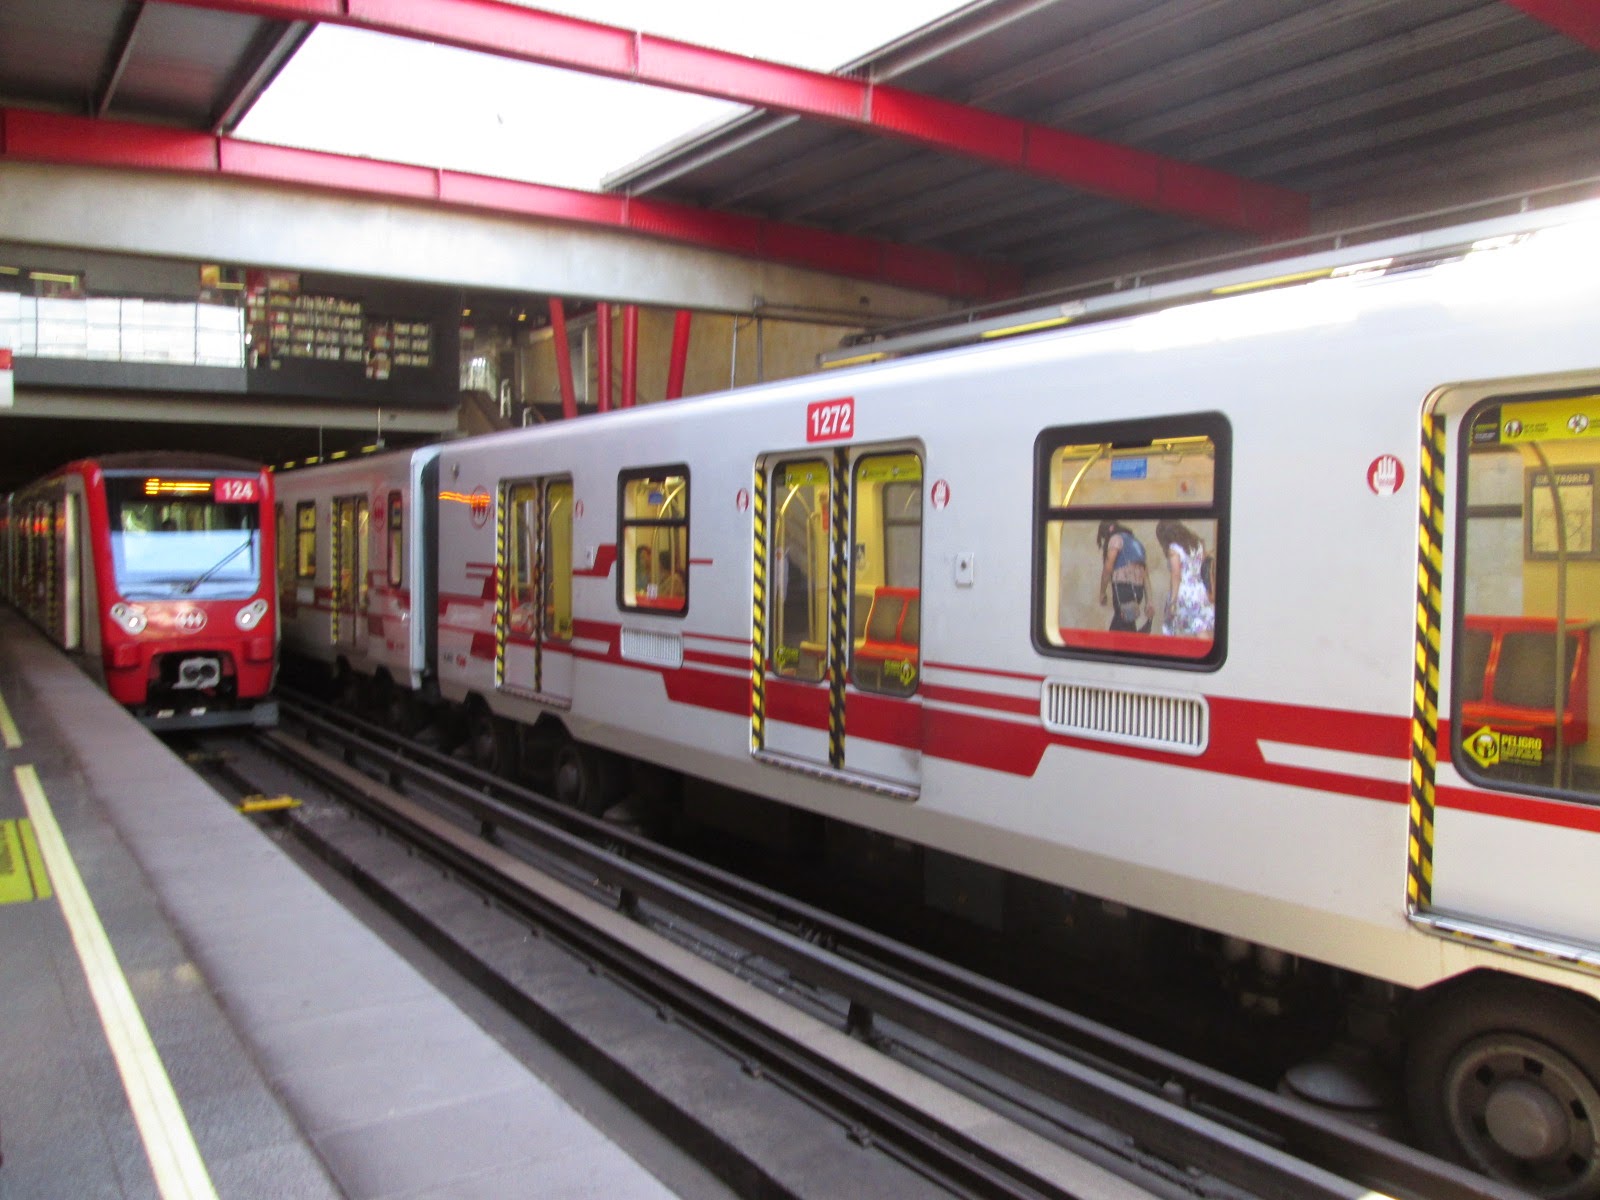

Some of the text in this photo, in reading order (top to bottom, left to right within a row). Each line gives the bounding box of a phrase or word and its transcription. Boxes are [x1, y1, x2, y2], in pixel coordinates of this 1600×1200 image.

[811, 402, 851, 437] 1272
[222, 480, 254, 500] 124
[1501, 734, 1542, 750] PELIGRO
